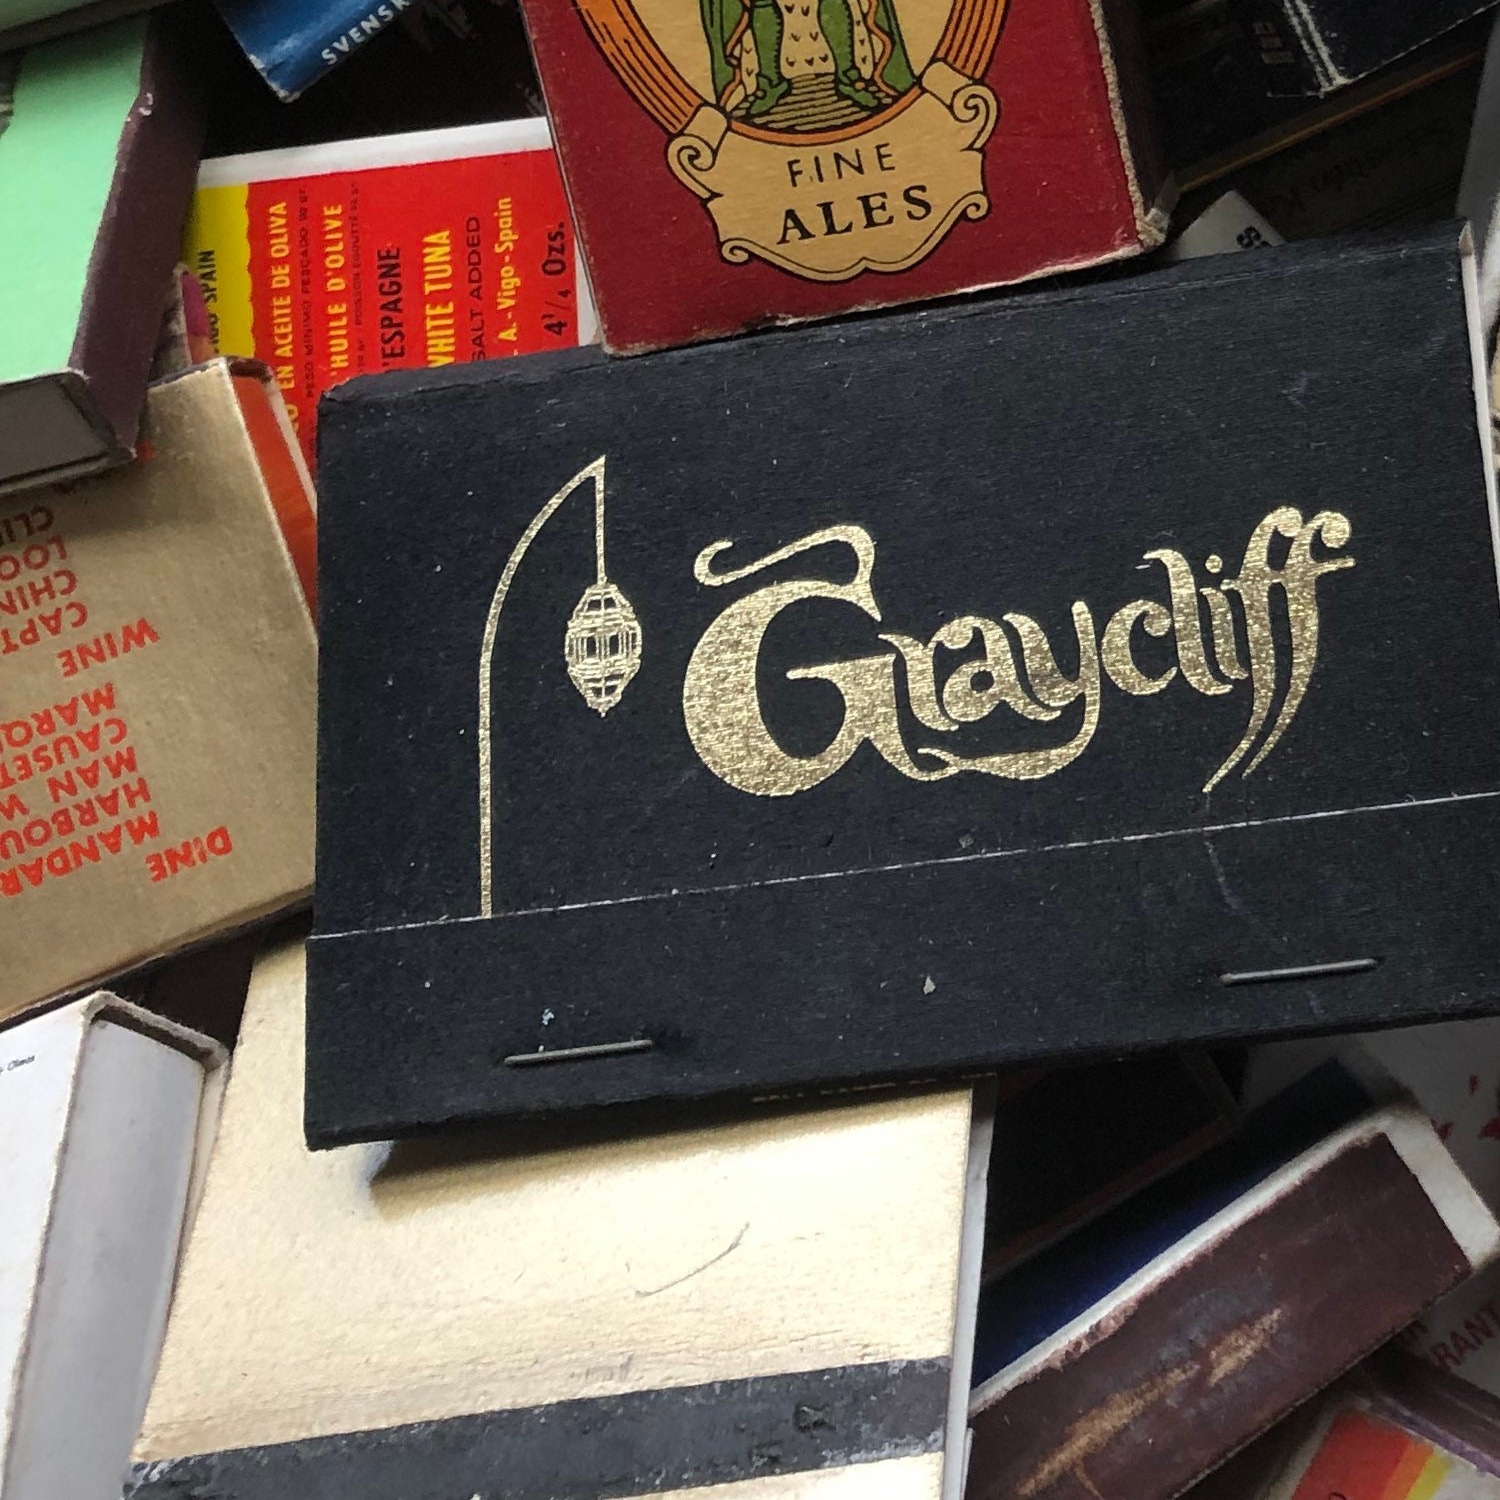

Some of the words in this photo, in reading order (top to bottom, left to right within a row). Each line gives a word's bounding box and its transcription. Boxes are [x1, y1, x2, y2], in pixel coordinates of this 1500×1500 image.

[786, 142, 897, 188] FINE
[267, 201, 290, 259] OLIVA
[776, 185, 934, 246] ALES
[271, 263, 291, 289] DE
[323, 203, 348, 294] D'OLIVE
[421, 230, 454, 296] TUNA
[466, 216, 483, 300] ADDED
[541, 221, 567, 276] Ozs.
[272, 295, 294, 358] ACEITE
[277, 361, 295, 390] EN
[59, 616, 160, 679] WINE
[683, 506, 1355, 797] Graycliff
[47, 747, 138, 803] MAN
[148, 825, 233, 883] DINE
